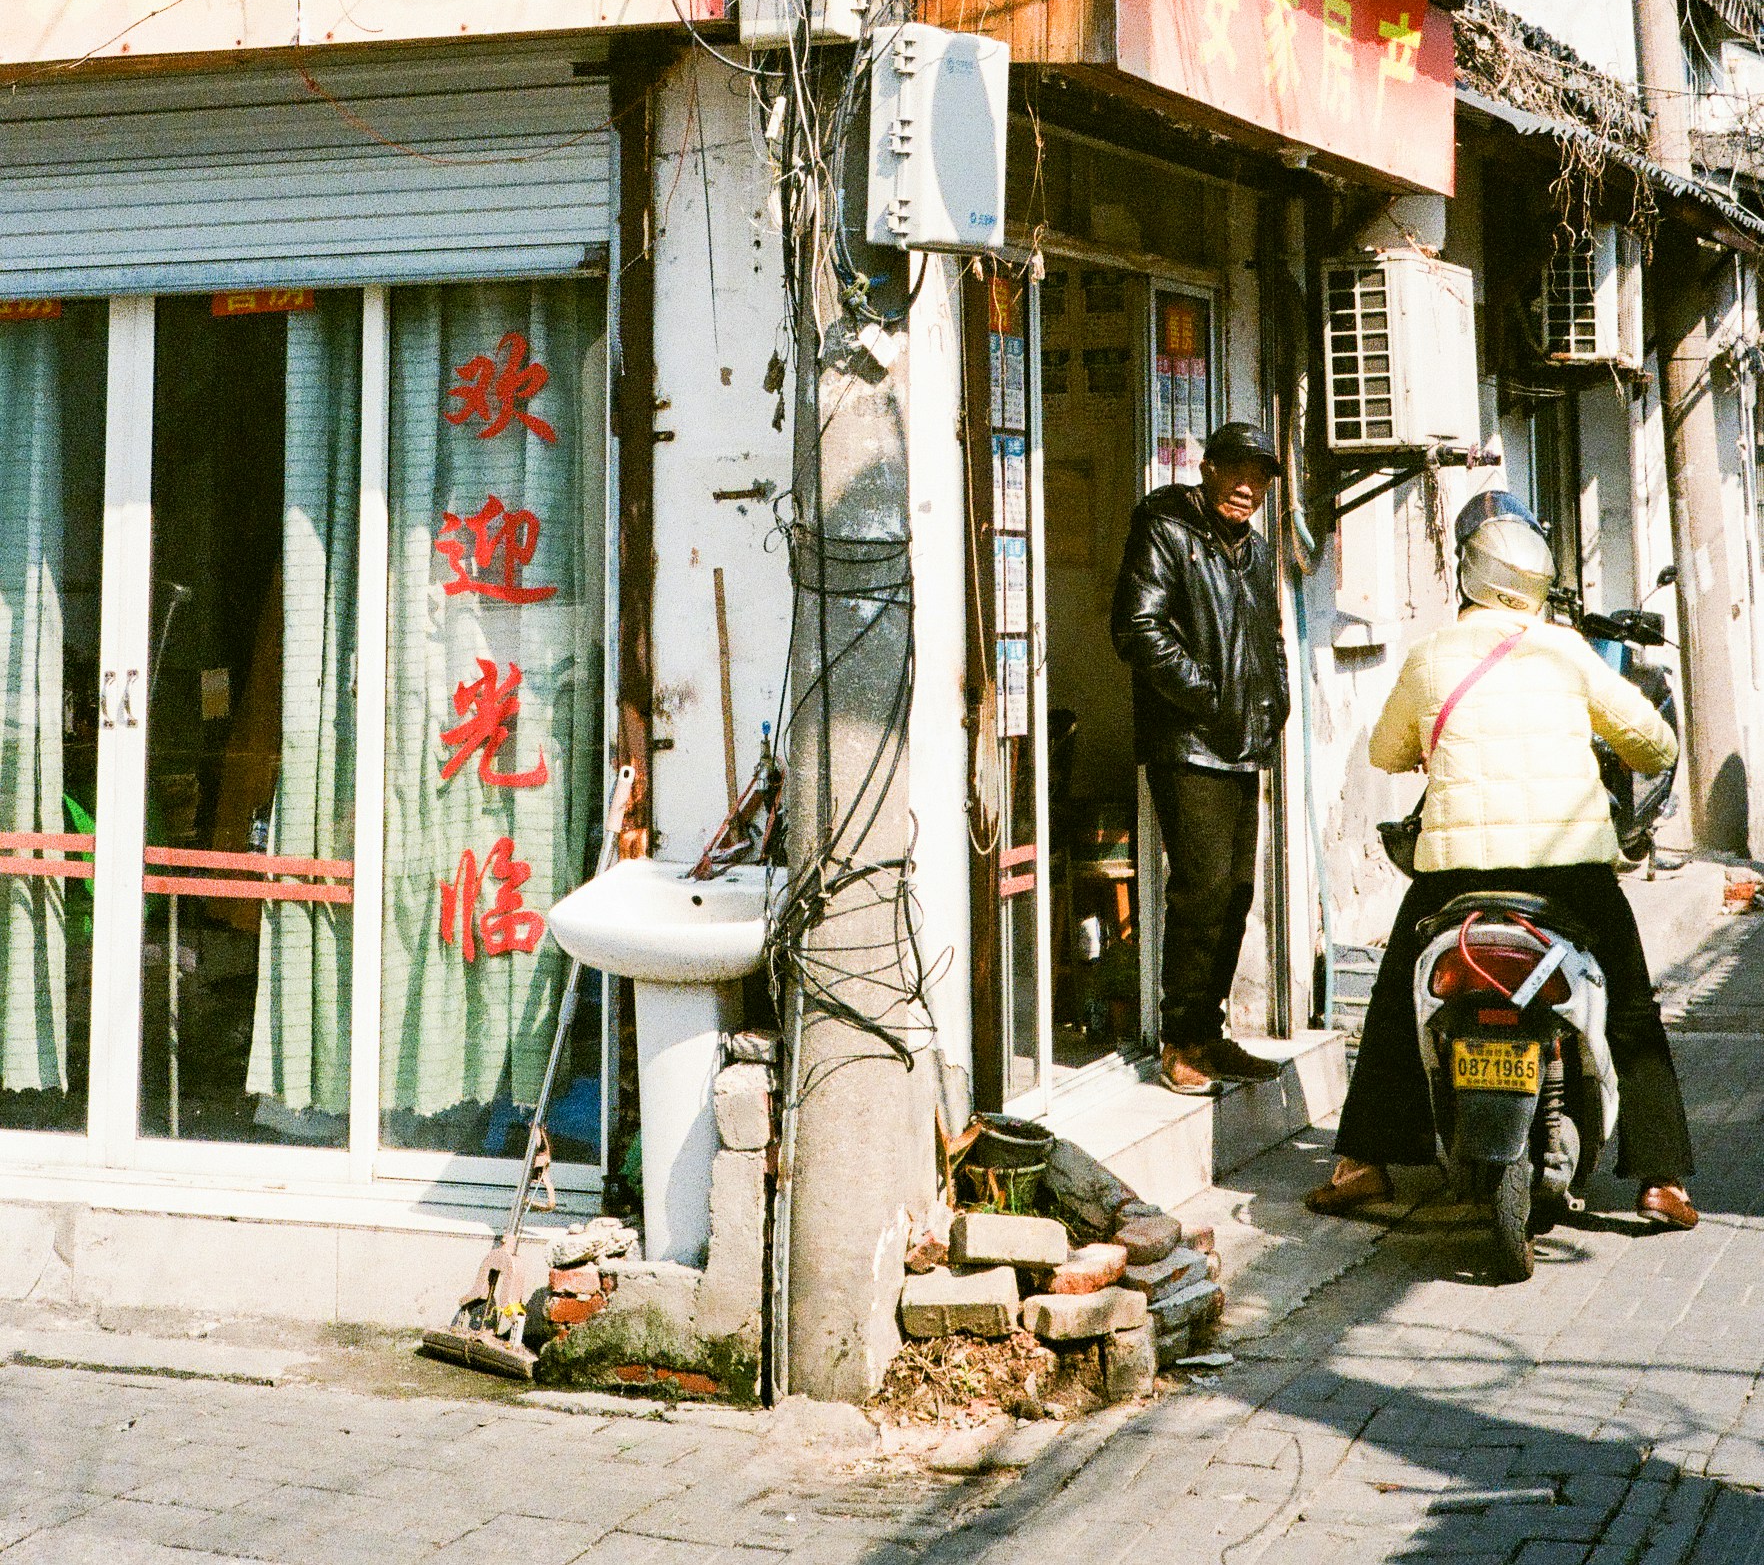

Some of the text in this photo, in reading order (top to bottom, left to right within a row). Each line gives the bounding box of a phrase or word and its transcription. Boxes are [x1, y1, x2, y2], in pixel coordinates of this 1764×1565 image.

[434, 332, 558, 963] 欢迎光临
[1458, 1057, 1535, 1079] 0871965
